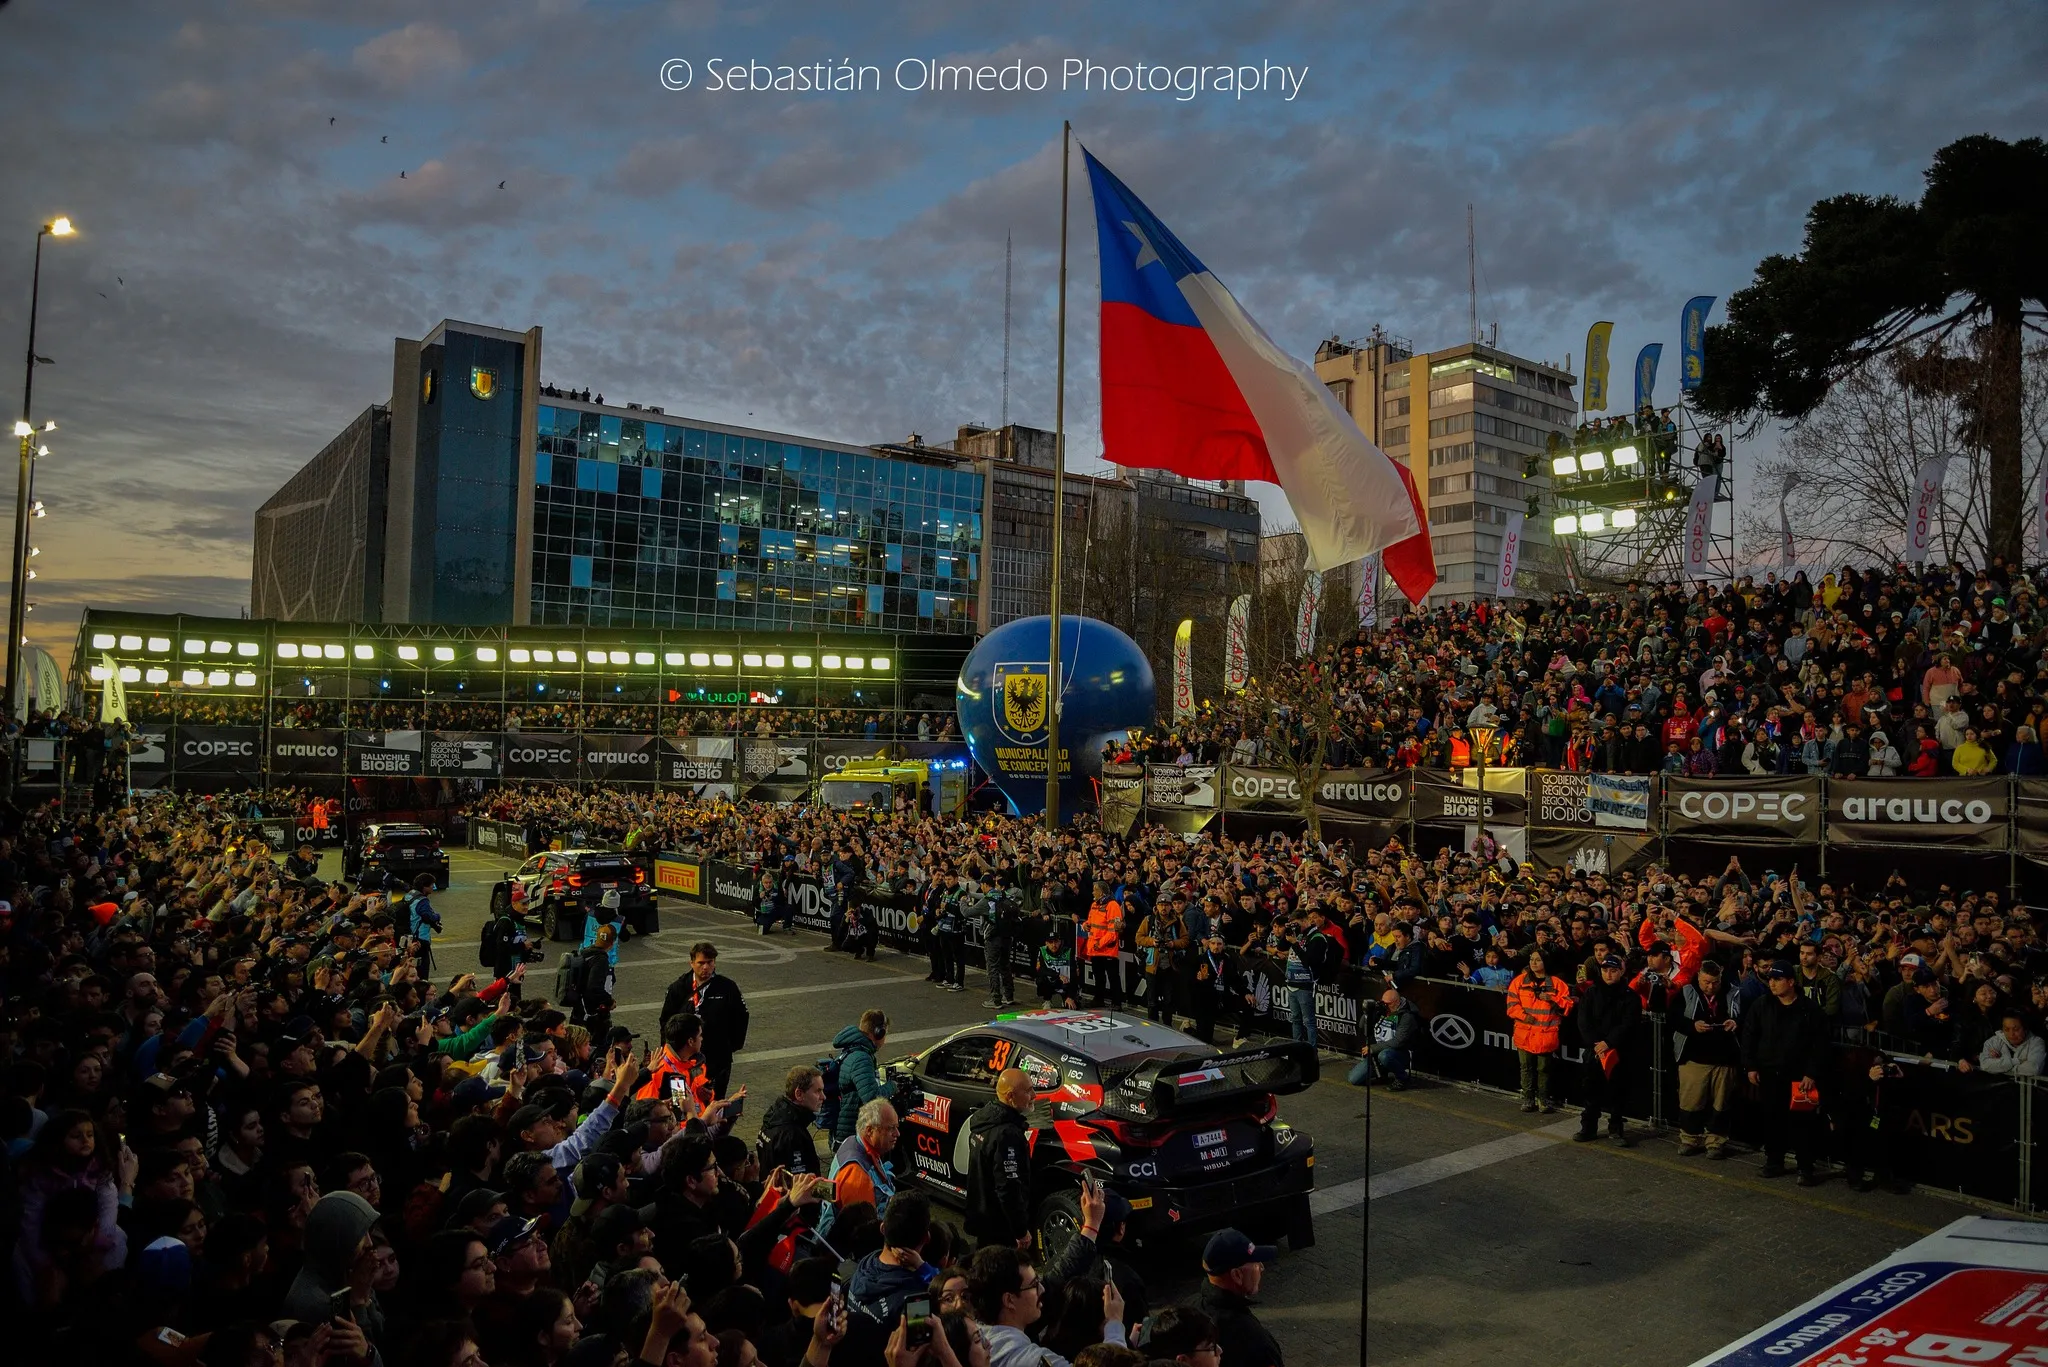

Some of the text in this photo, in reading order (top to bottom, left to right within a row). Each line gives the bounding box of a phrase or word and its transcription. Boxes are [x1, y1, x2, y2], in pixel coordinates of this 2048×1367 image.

[1914, 479, 1936, 549] COPEC
[1502, 532, 1516, 588] COPEC
[183, 741, 254, 756] COPEC
[276, 744, 338, 757] arauco
[509, 749, 572, 763] COPEC
[995, 747, 1069, 760] MUNICIPALIAD
[361, 753, 411, 762] RALLYCHILE
[587, 751, 650, 764] arauco
[673, 761, 723, 770] RALLYCHILE
[999, 760, 1071, 772] DE CONCEPÓN
[1232, 776, 1301, 800] COPEC
[1322, 782, 1402, 801] arauco
[1542, 784, 1589, 796] REGIONA
[1443, 795, 1493, 806] RALLYCHLE
[1577, 797, 1588, 807] DE
[1679, 792, 1806, 822] COPEC
[1443, 804, 1494, 818] BIOBO
[1842, 796, 1992, 824] arauco
[297, 824, 339, 842] COEC
[659, 865, 696, 889] PIRELLI
[787, 884, 833, 918] MDS
[792, 916, 808, 926] ASINO
[812, 919, 832, 929] HOTELE
[988, 1040, 1011, 1071] 33
[1200, 1050, 1270, 1070] Panasonic
[1200, 1132, 1222, 1145] A-7444
[1851, 1270, 1928, 1305] COPEC
[1764, 1312, 1852, 1356] arauco
